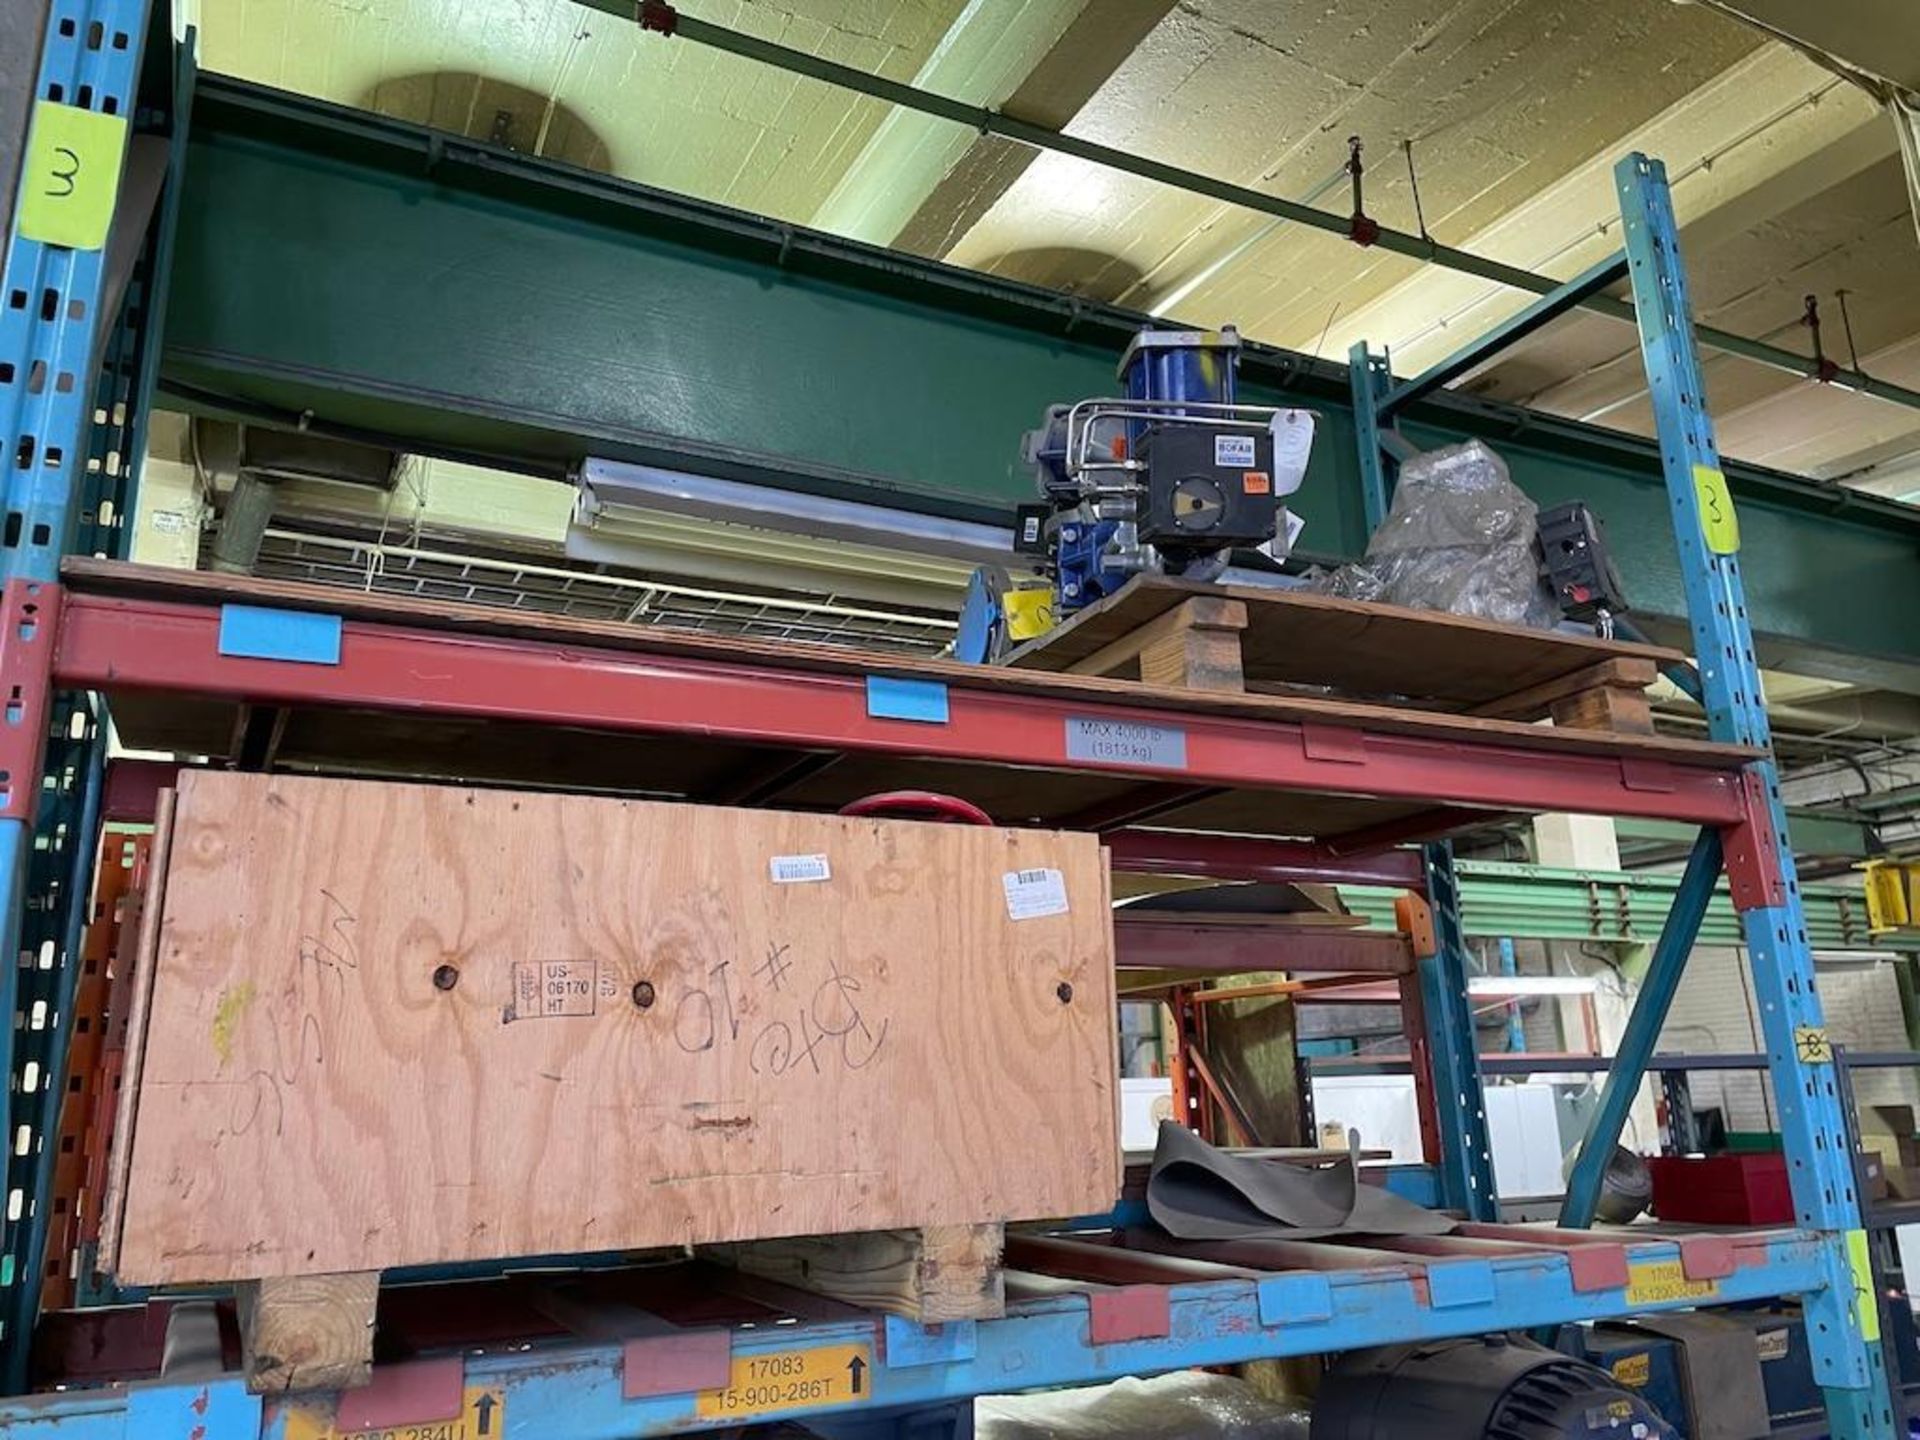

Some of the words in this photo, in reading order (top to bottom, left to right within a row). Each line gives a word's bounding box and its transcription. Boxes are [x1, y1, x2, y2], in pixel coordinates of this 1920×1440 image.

[44, 147, 80, 197] 3
[1704, 485, 1722, 523] 3
[1080, 720, 1112, 736] MAX
[1114, 724, 1147, 741] 4000
[1130, 744, 1153, 762] kg)
[546, 980, 591, 996] 06170
[546, 998, 565, 1013] HT
[749, 1356, 804, 1379] 17083
[716, 1378, 833, 1410] 15-900-286T
